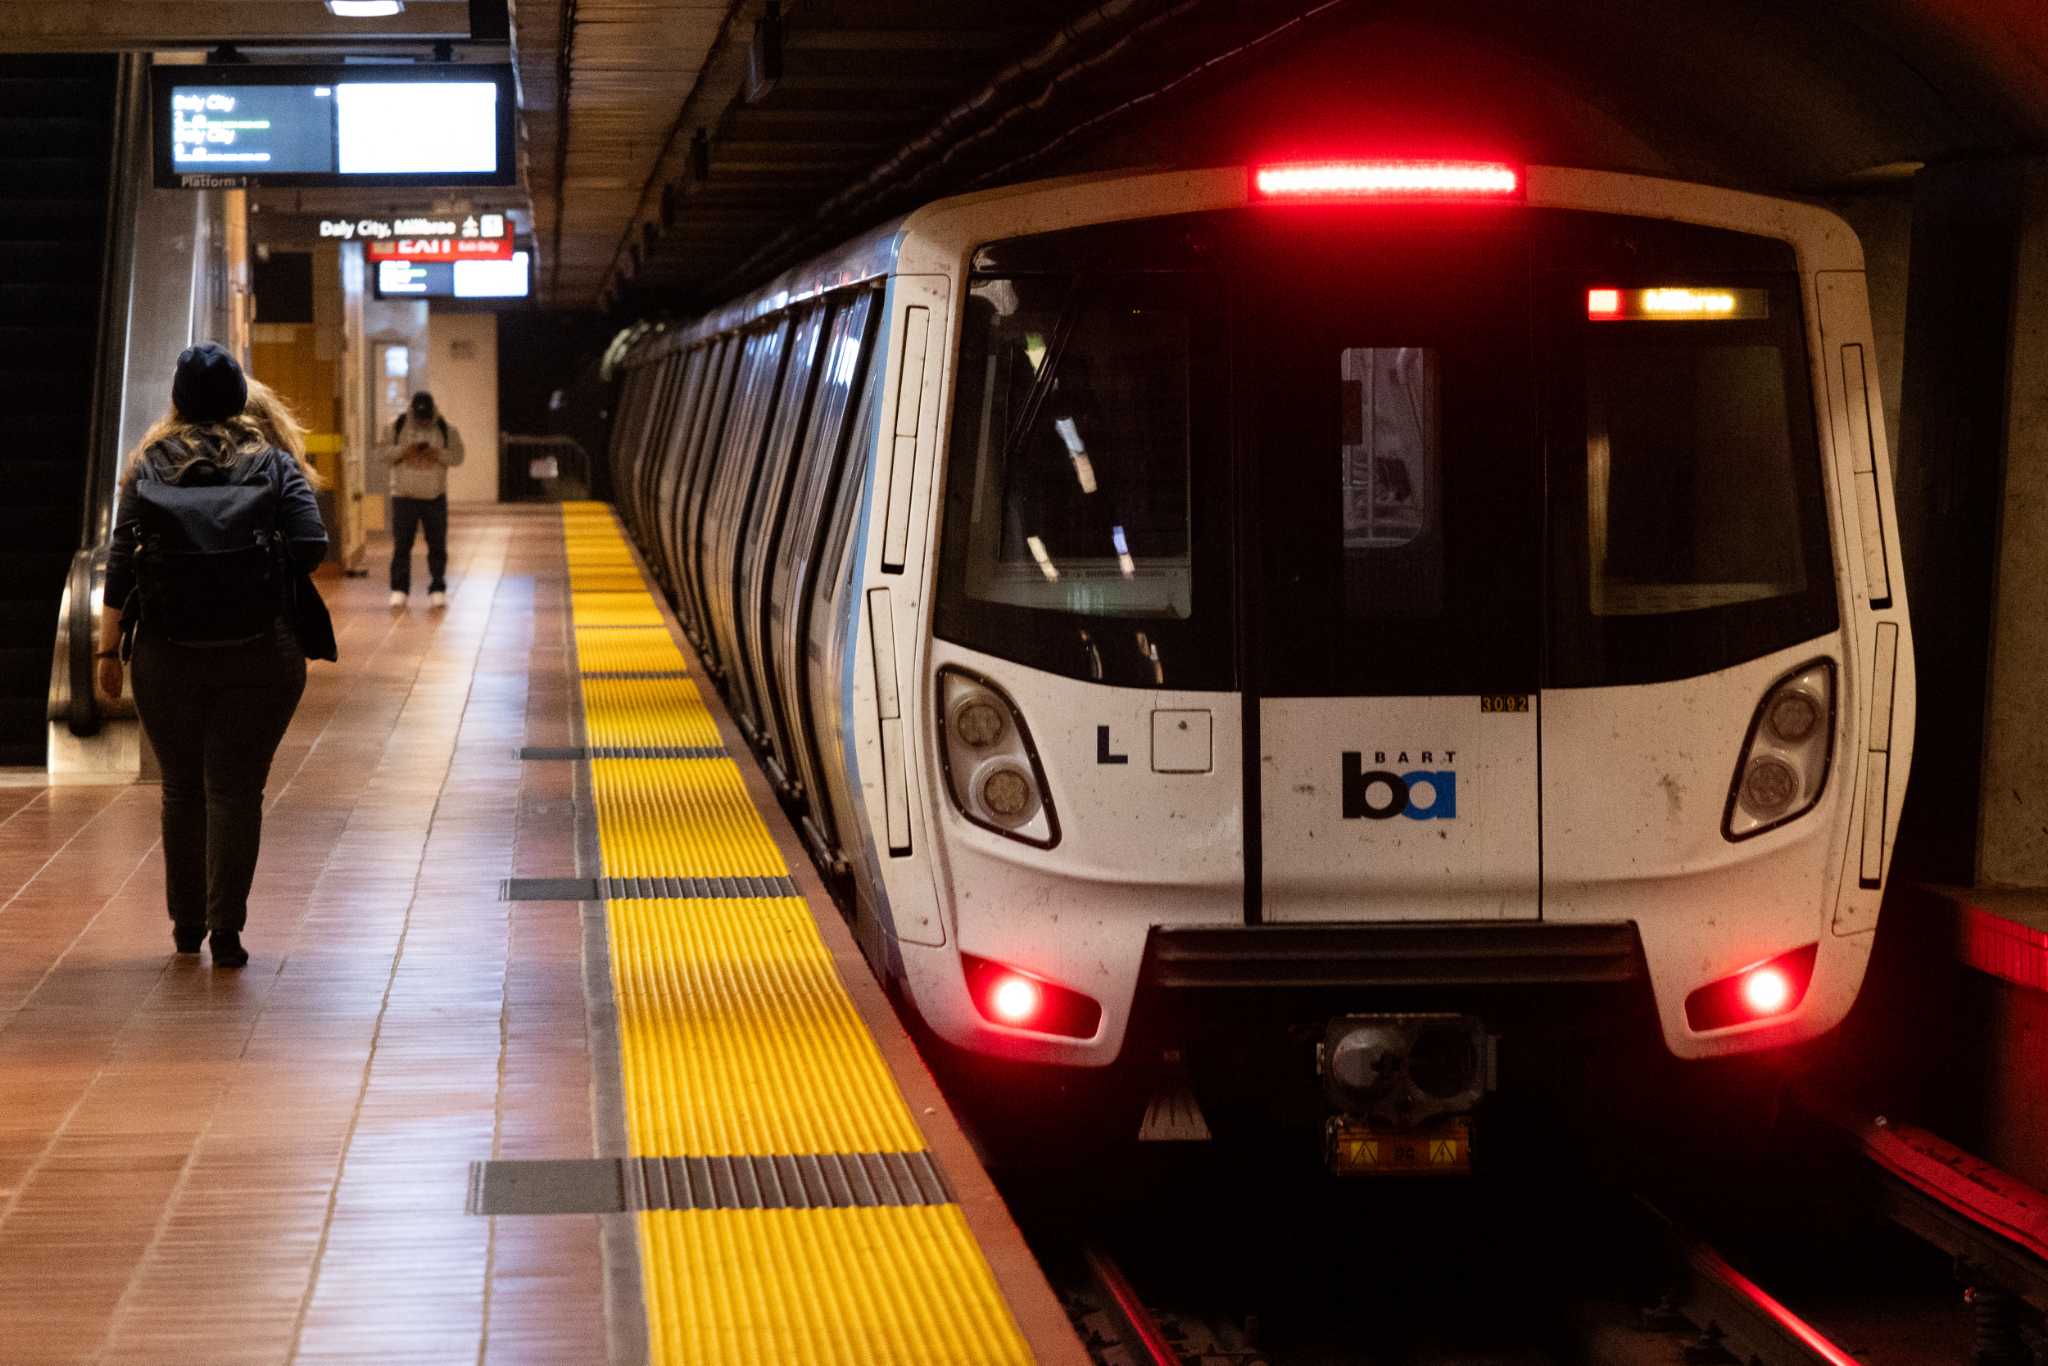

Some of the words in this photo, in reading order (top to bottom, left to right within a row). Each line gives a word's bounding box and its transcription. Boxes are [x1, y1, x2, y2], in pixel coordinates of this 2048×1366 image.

[182, 175, 236, 187] Platform
[320, 220, 355, 239] Daly
[1482, 696, 1527, 711] 3092
[1097, 725, 1128, 764] L
[1374, 751, 1456, 763] BART
